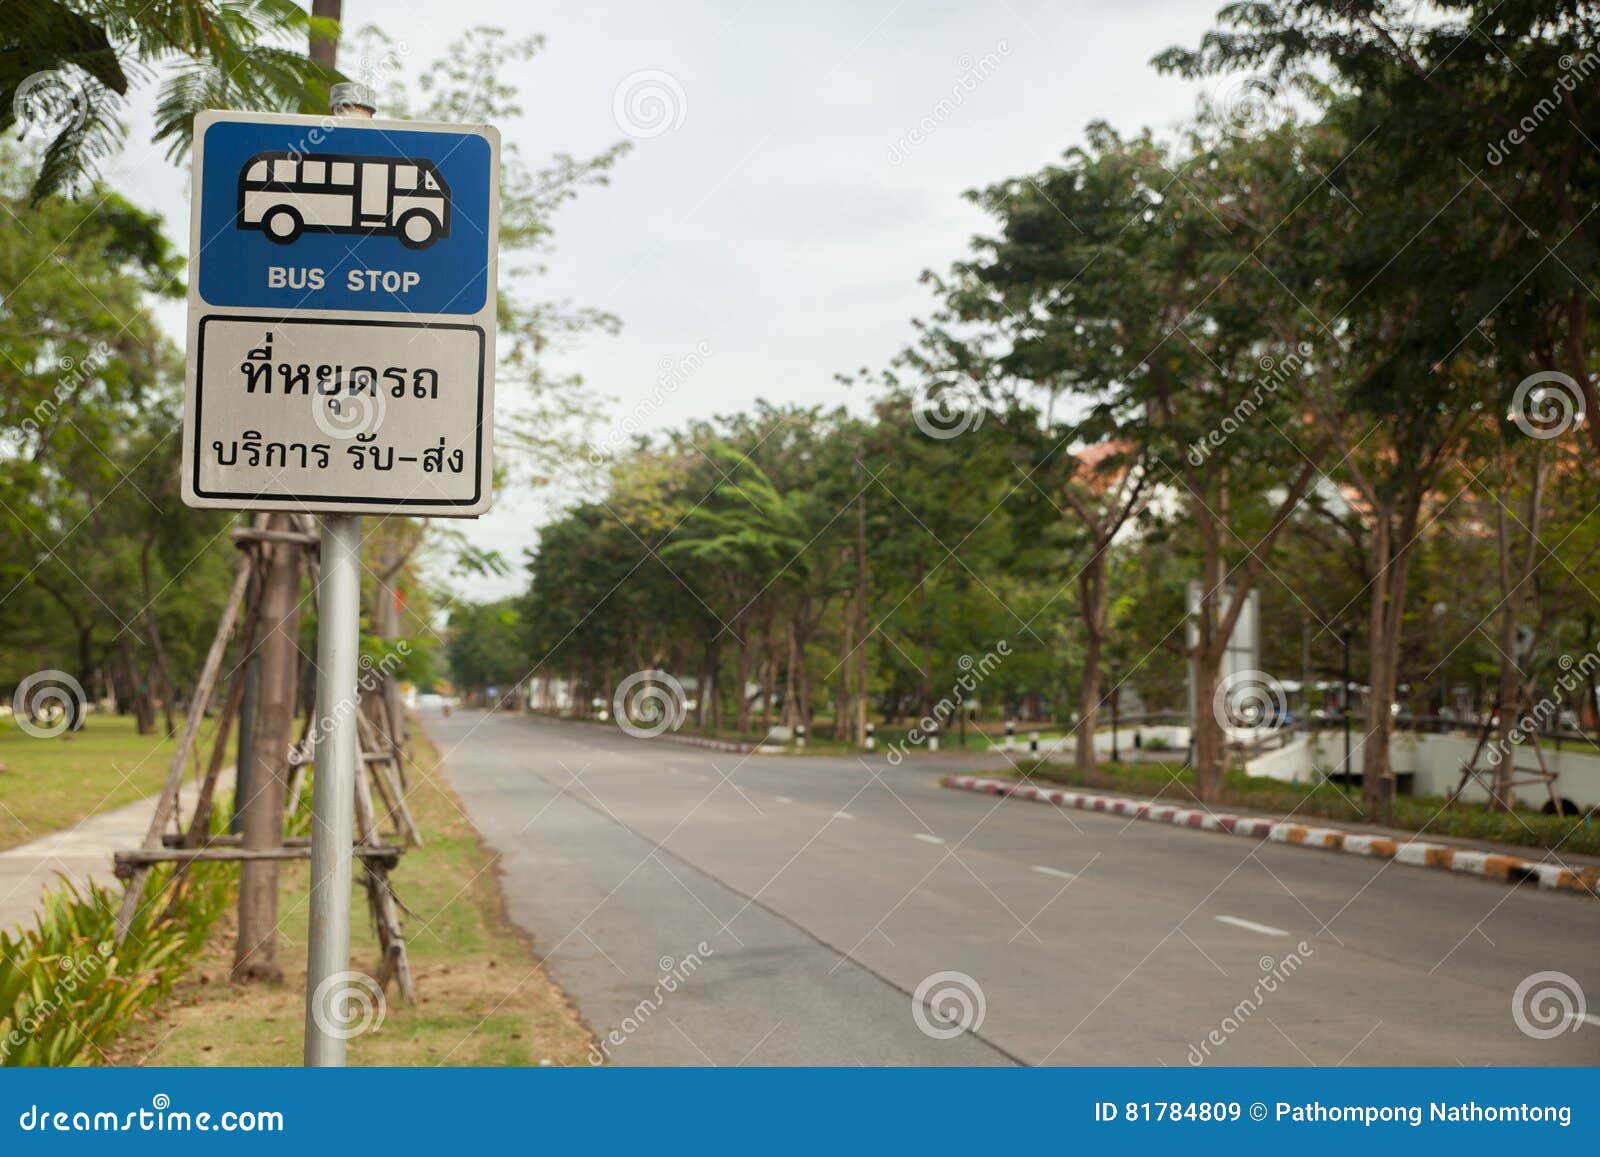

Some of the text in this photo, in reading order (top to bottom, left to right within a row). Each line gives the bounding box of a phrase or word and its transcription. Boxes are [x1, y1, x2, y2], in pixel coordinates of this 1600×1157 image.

[267, 266, 420, 293] BUS STOP
[240, 332, 439, 416] ที่หยุดรถ
[212, 430, 464, 473] บริการ รับ-ส่ง
